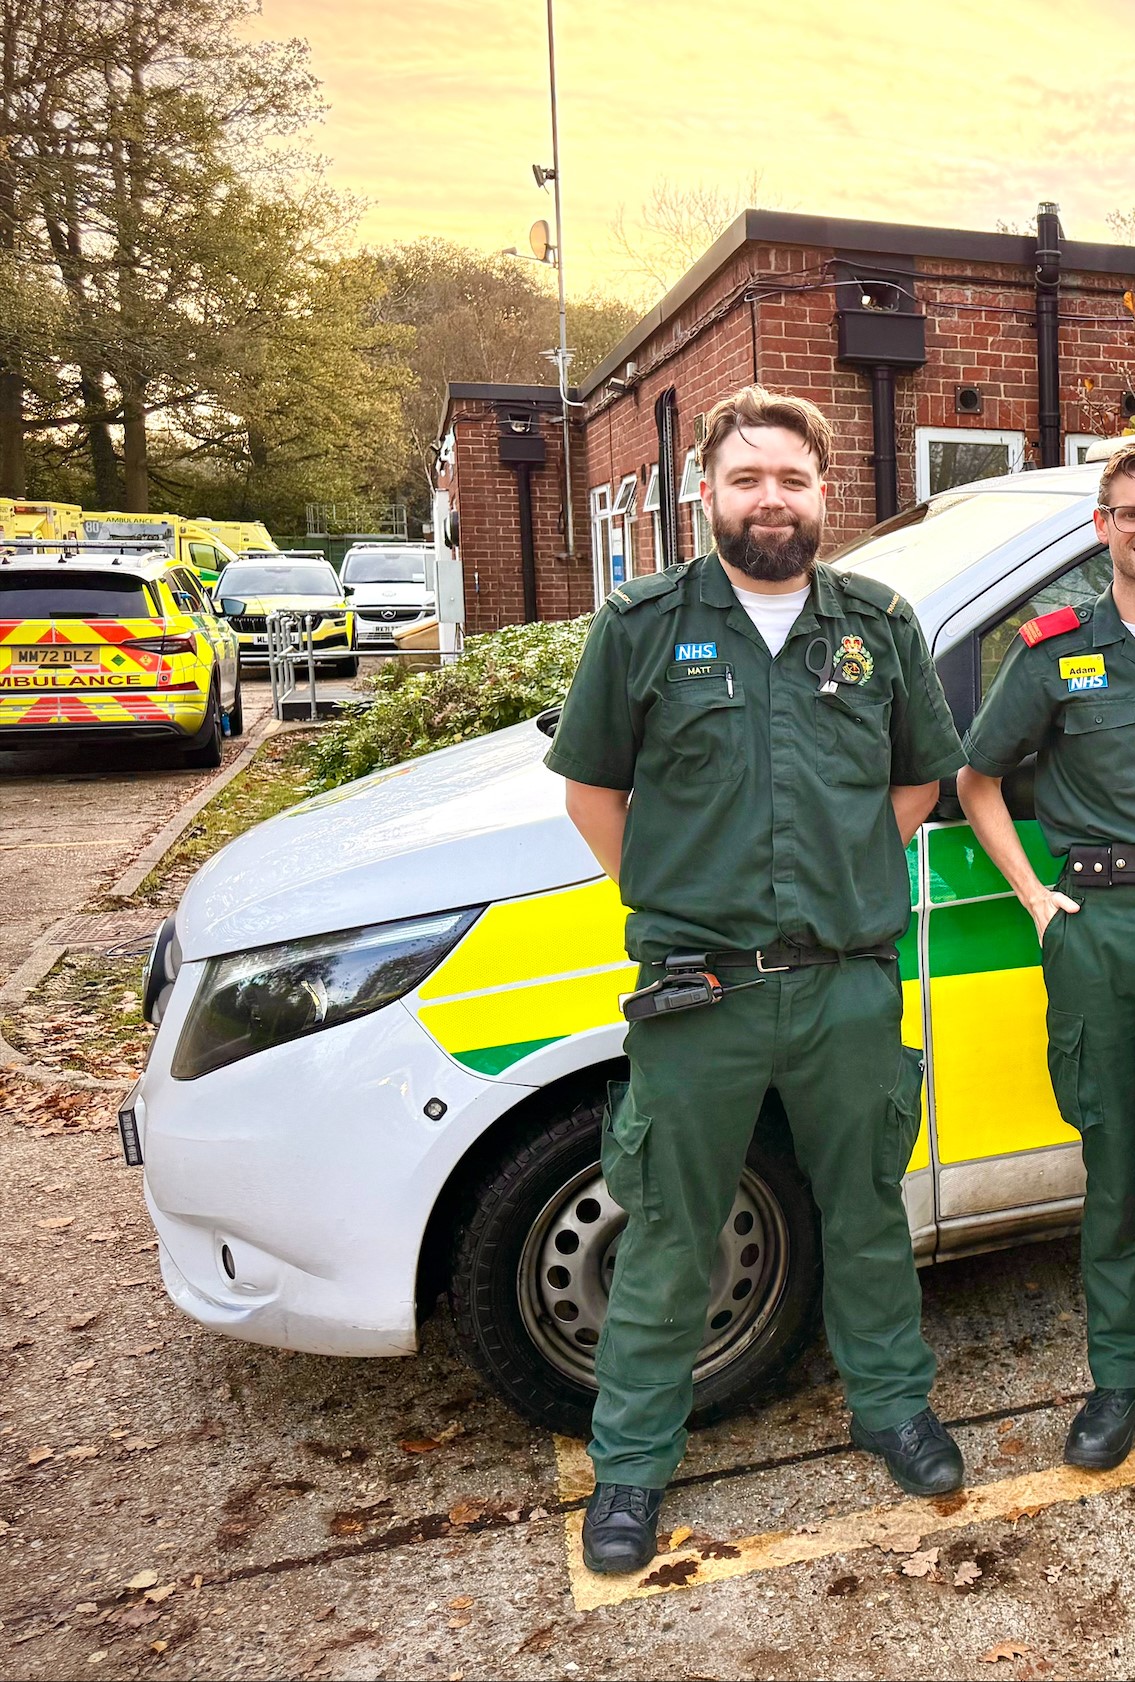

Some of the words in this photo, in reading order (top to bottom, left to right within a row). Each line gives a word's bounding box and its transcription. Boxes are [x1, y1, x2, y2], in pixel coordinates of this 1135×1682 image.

[85, 521, 100, 533] 80
[19, 650, 59, 662] MM72
[64, 650, 93, 662] DLZ
[679, 644, 714, 660] NHS
[687, 665, 712, 676] MATT
[1070, 667, 1096, 675] Adam
[1071, 674, 1104, 690] NHS
